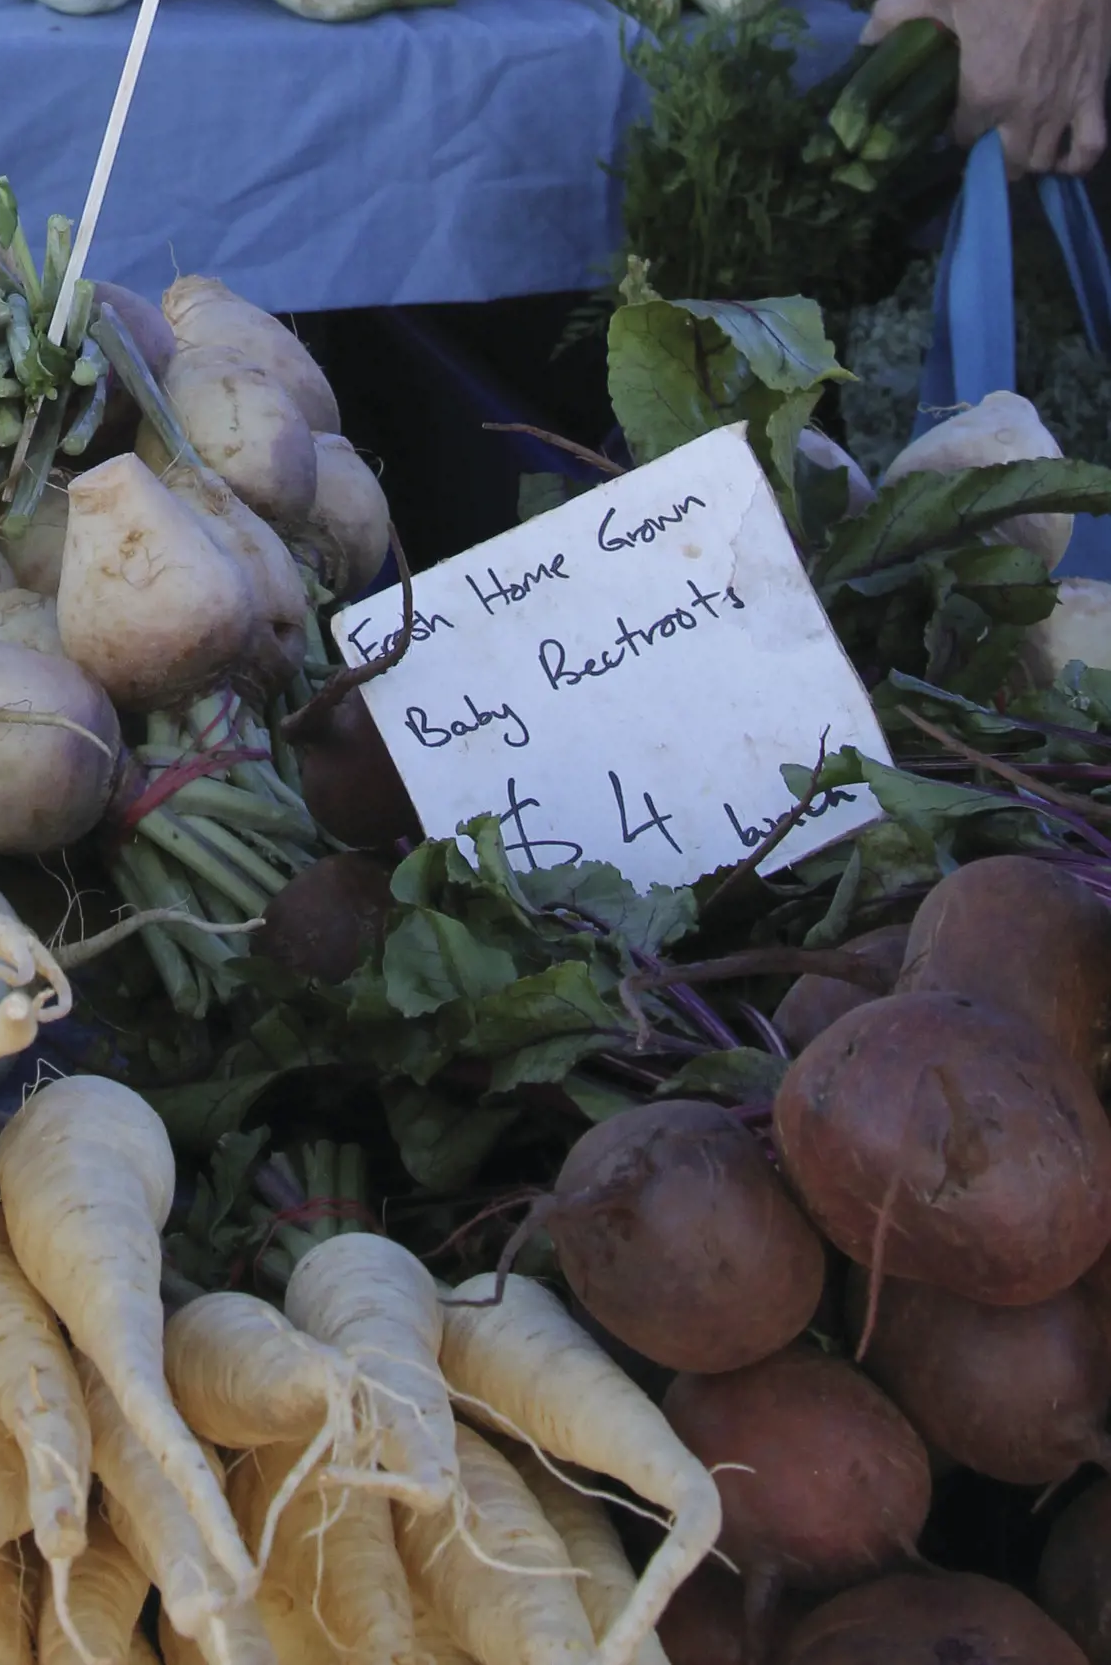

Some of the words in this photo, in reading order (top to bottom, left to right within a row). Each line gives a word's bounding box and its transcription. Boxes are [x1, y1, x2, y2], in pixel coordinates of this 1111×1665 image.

[465, 552, 571, 616] Home
[598, 495, 706, 552] Grown
[404, 694, 530, 748] Baby
